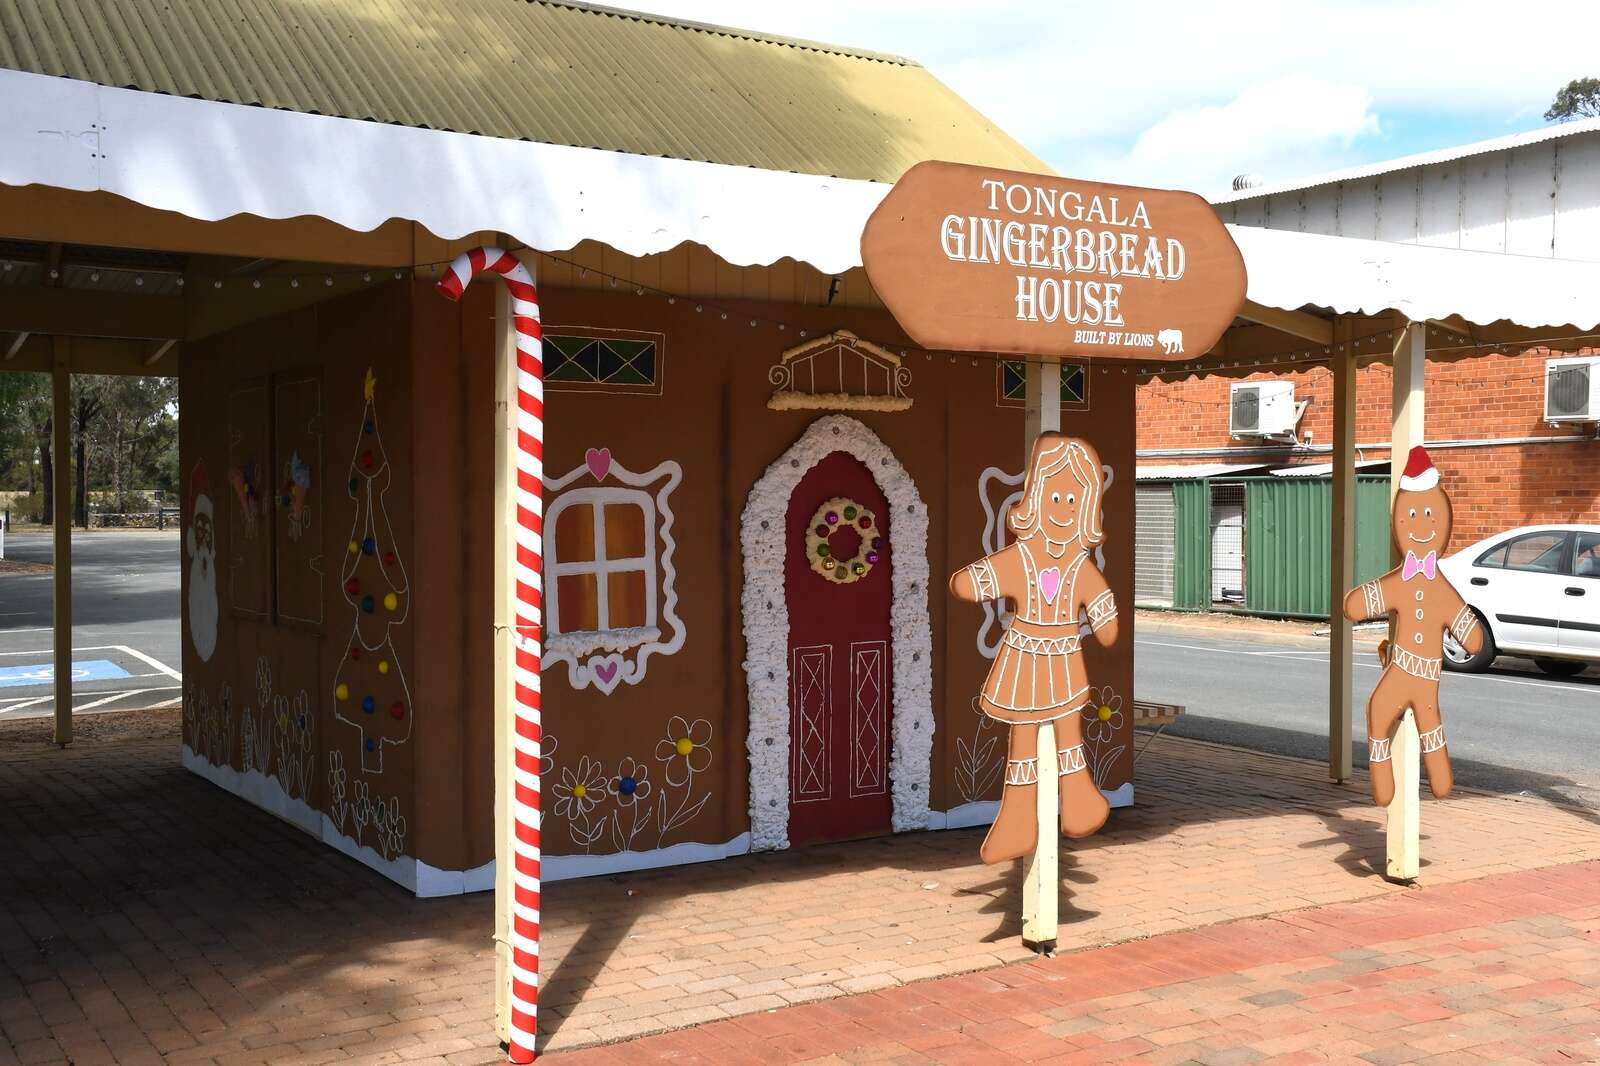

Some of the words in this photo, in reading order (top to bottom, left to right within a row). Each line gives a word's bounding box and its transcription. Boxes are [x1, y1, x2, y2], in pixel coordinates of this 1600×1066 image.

[982, 179, 1152, 230] TONGALA
[940, 214, 1185, 281] GINGERBREAD
[1015, 275, 1125, 327] HOUSE
[1074, 330, 1106, 345] BUILT
[1108, 331, 1122, 346] BY
[1124, 332, 1154, 347] LIONS
